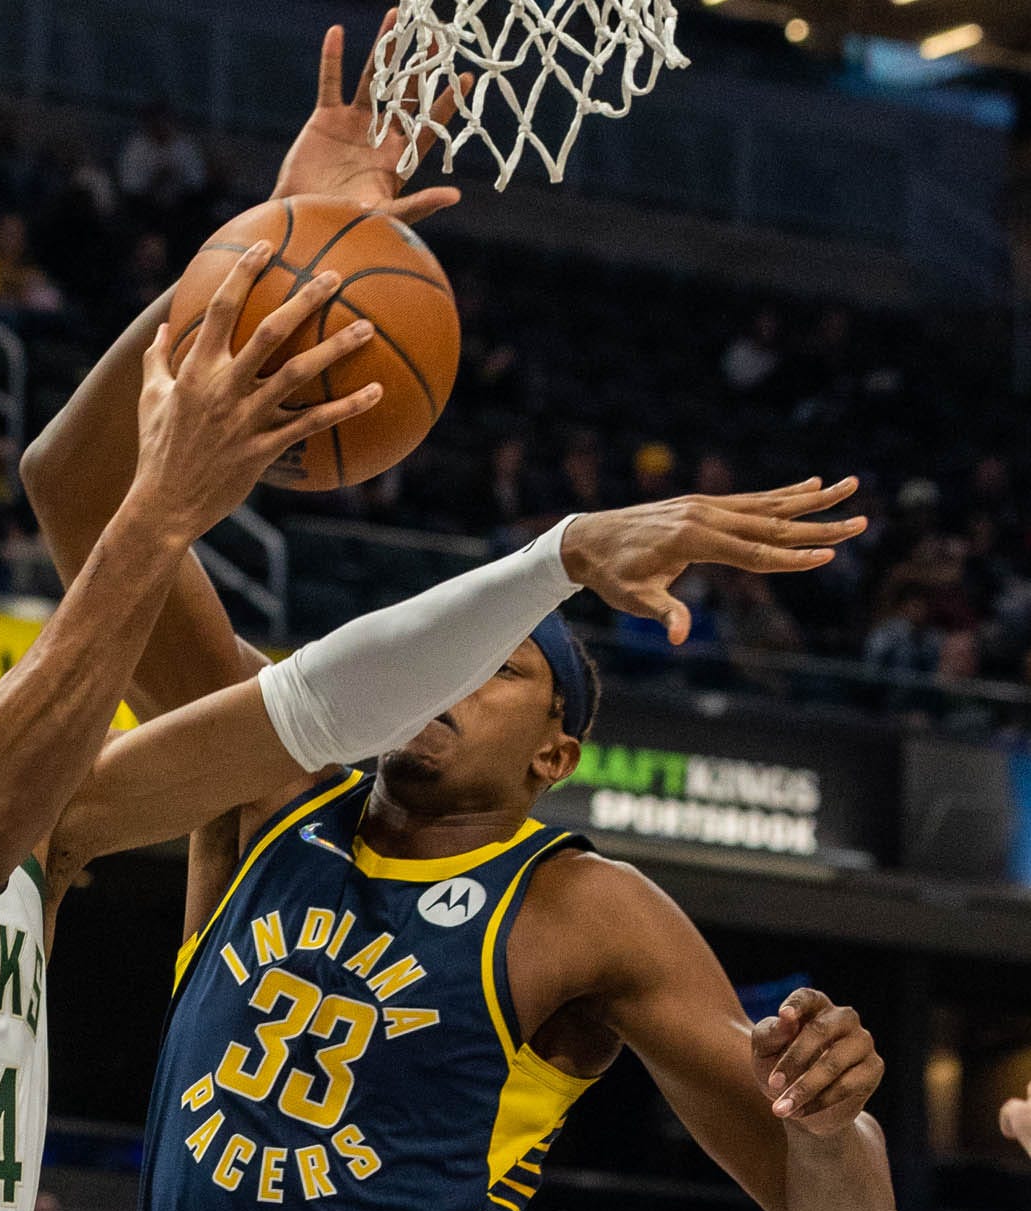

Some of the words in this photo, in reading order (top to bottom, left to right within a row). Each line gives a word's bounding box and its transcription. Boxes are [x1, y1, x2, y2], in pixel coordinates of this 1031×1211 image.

[551, 742, 819, 815] RAFTKINGS
[590, 790, 817, 856] SPORTSBOOK
[220, 907, 440, 1040] INDIANA
[215, 967, 378, 1129] 33
[181, 1072, 382, 1203] PACERS
